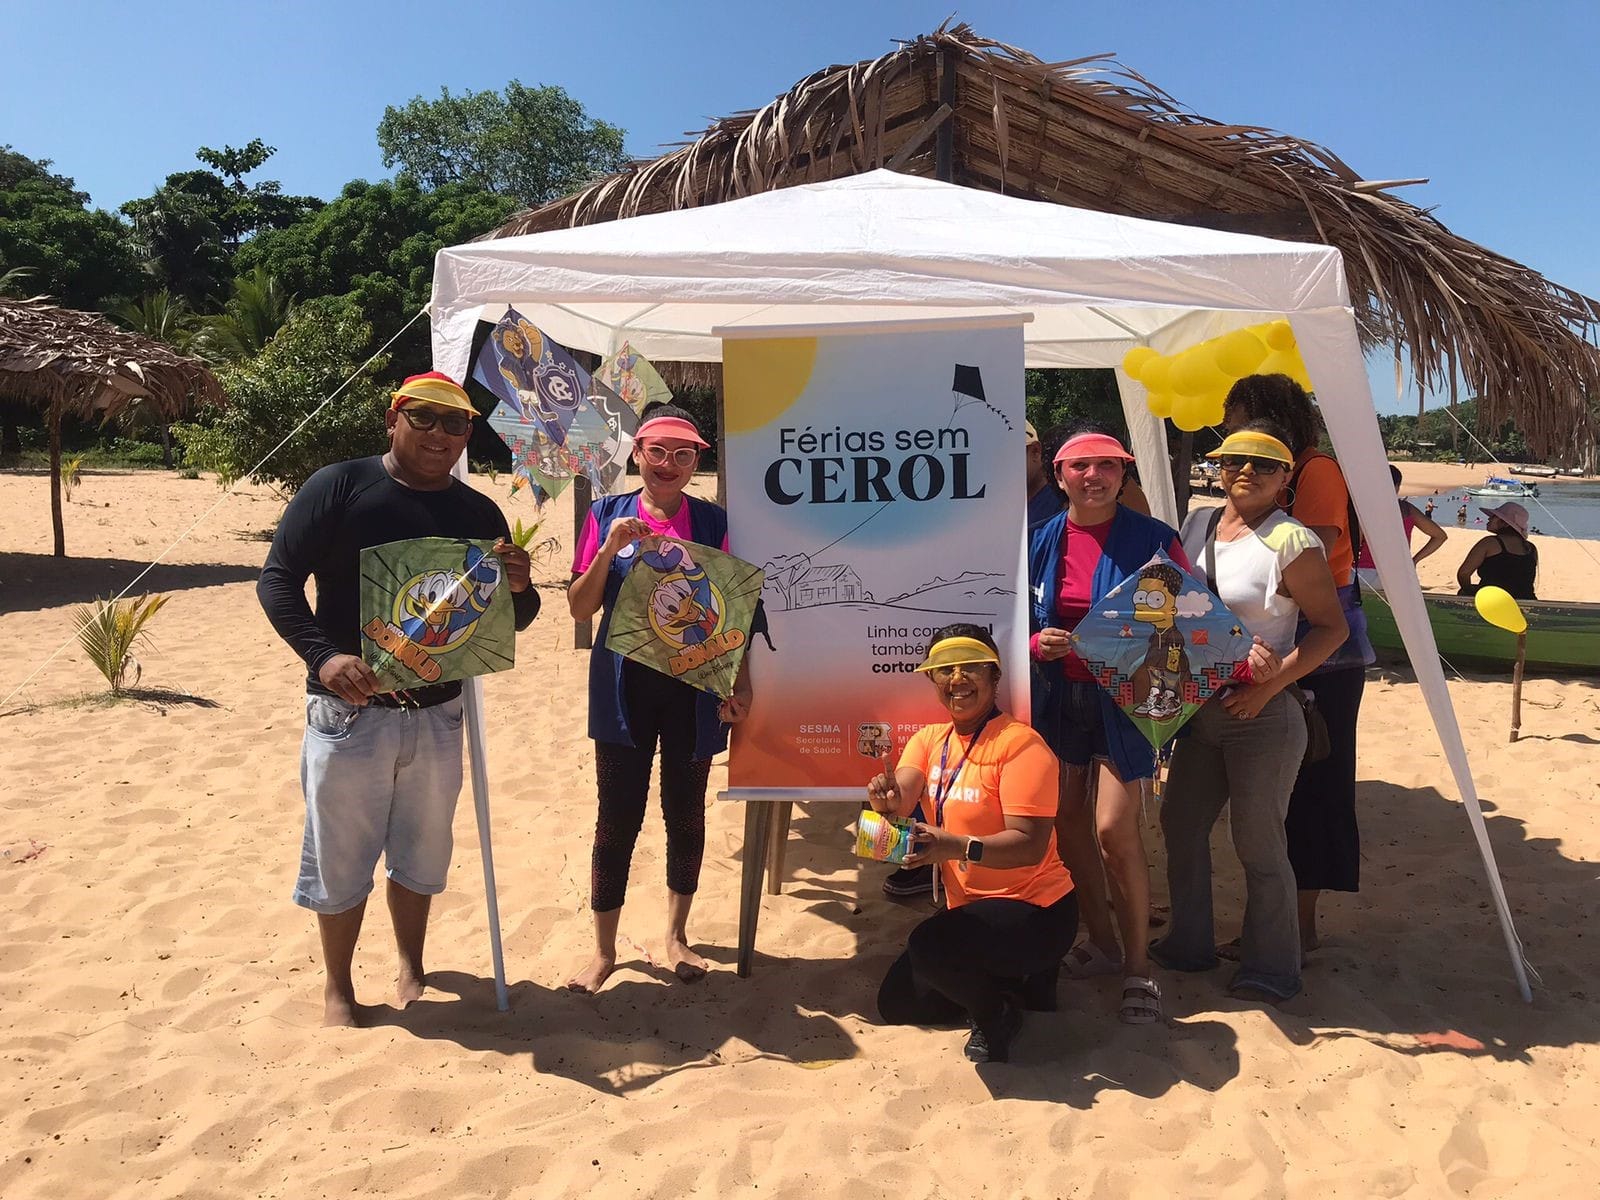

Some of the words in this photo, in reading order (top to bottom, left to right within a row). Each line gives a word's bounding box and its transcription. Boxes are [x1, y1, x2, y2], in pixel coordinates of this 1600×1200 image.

[780, 425, 885, 454] Férias
[895, 427, 969, 451] sem
[764, 453, 986, 505] CEROL
[867, 624, 908, 639] Linha
[362, 615, 443, 683] DONALD
[668, 628, 746, 676] DONALD
[872, 642, 929, 656] també
[799, 724, 841, 734] SESMA
[795, 735, 841, 744] Secretaria
[799, 745, 811, 755] de
[813, 745, 841, 755] Saúde
